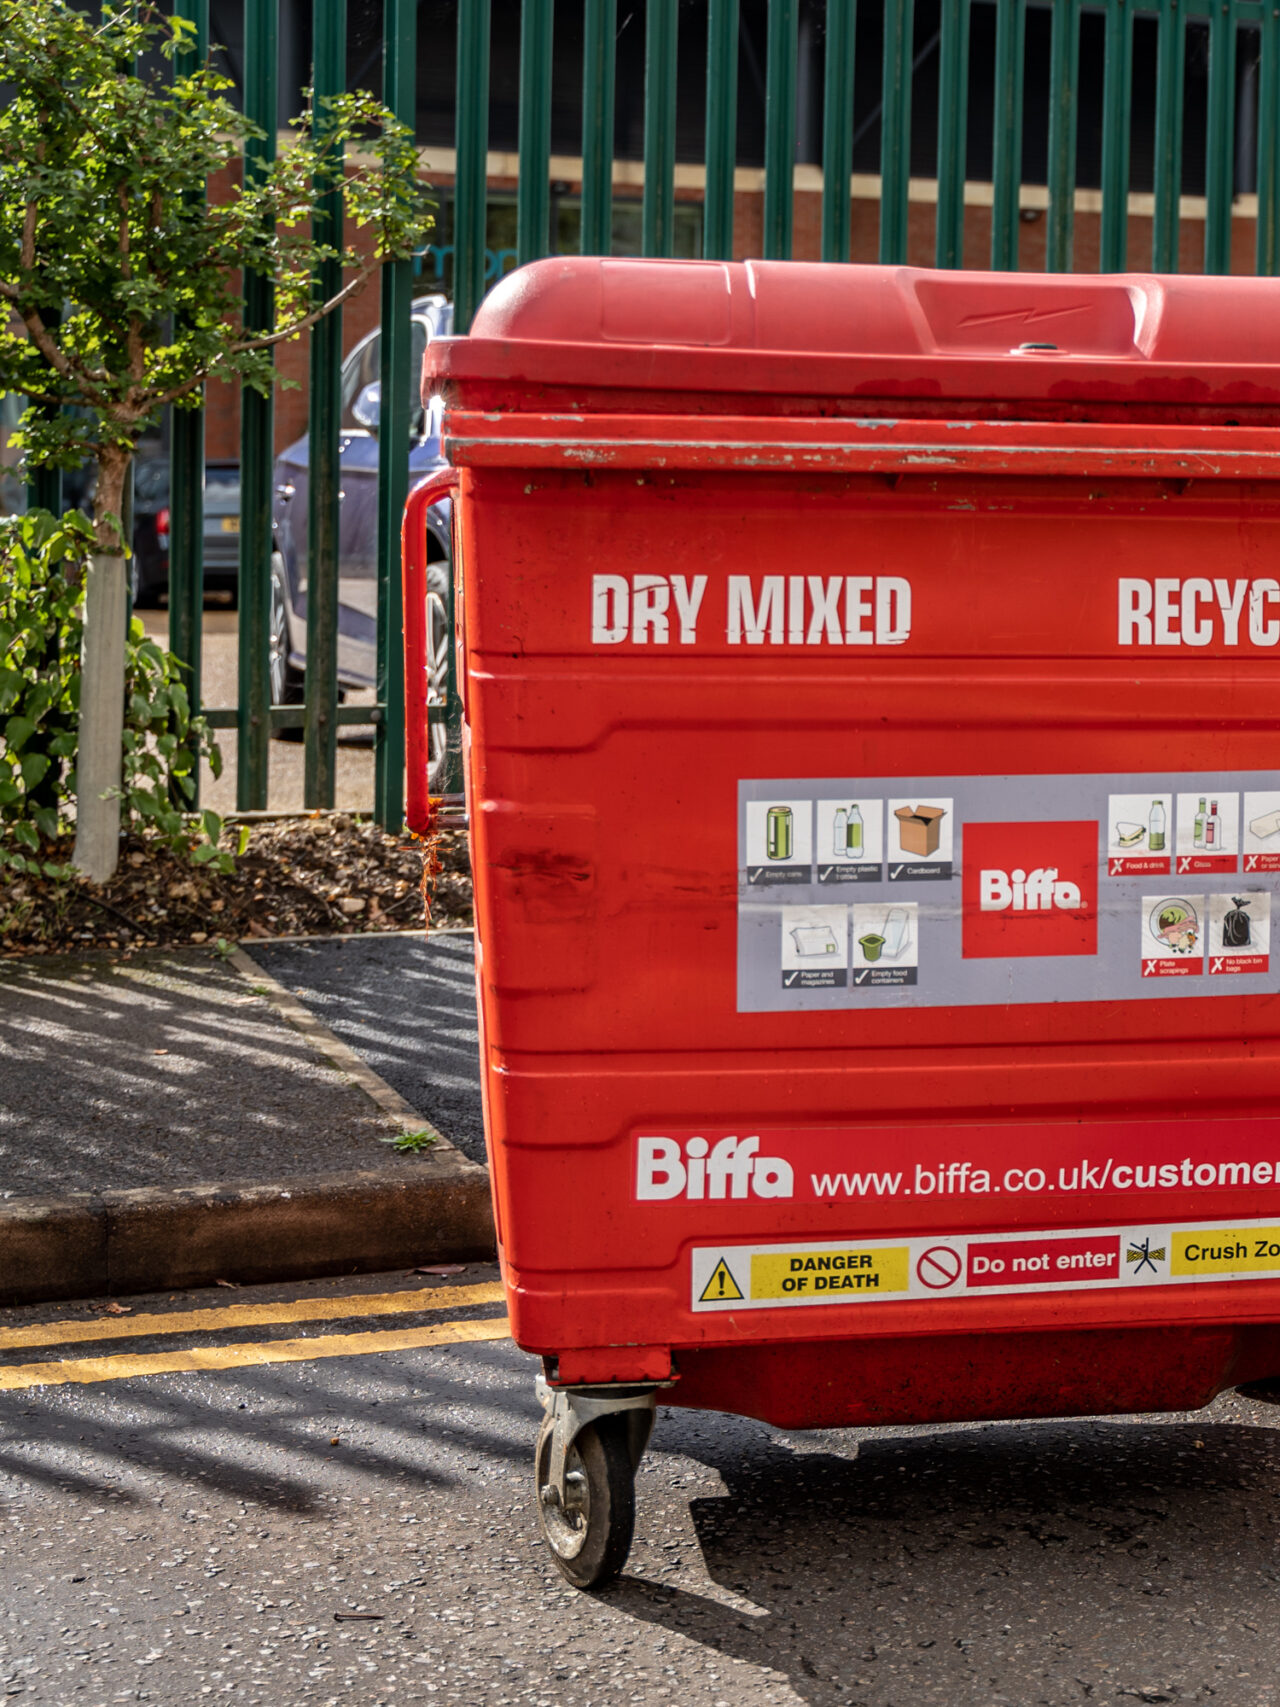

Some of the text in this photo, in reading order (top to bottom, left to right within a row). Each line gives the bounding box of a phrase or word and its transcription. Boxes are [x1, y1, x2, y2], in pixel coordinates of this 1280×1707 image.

[592, 574, 912, 645] DRY MIXED
[836, 865, 857, 874] Empty
[907, 867, 941, 875] Cardboard
[980, 867, 1082, 911] Biffa
[801, 971, 820, 979] Paper
[871, 970, 892, 978] Empty
[636, 1136, 794, 1200] Biffa
[1184, 1242, 1248, 1261] Crush
[790, 1255, 873, 1272] DANGER
[972, 1251, 1116, 1274] Do not enter
[782, 1274, 880, 1292] OF DEATH
